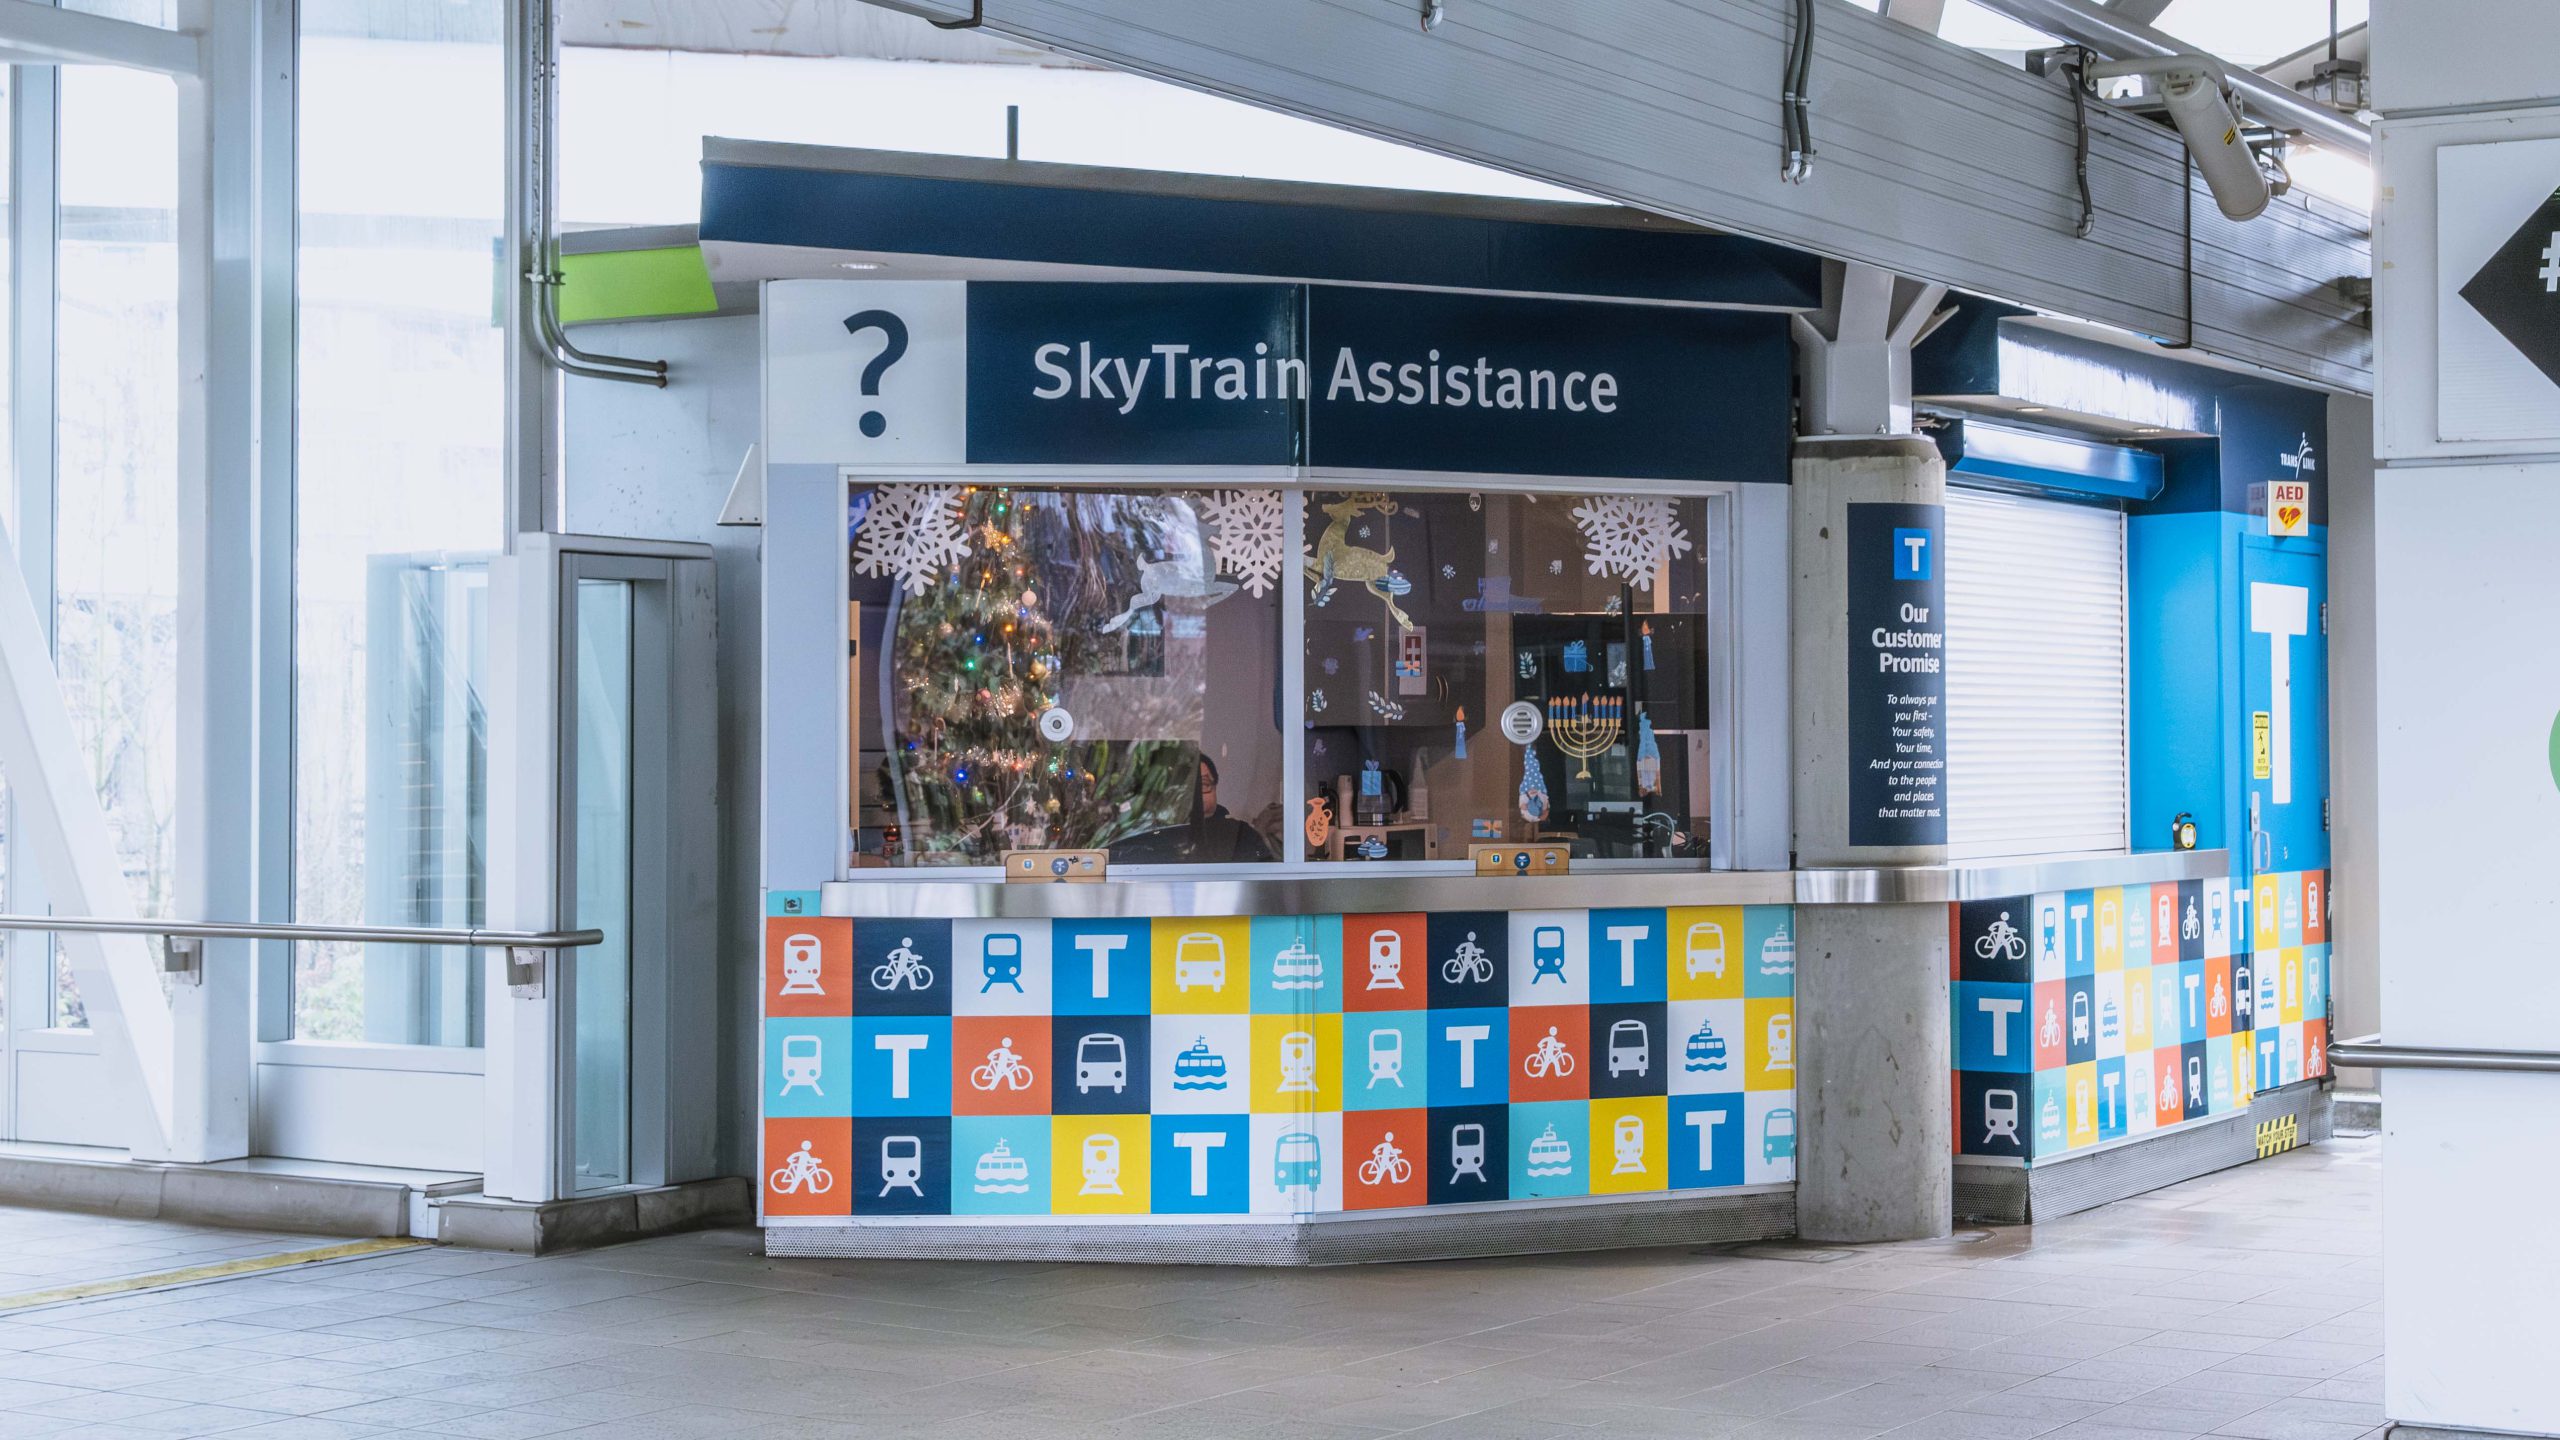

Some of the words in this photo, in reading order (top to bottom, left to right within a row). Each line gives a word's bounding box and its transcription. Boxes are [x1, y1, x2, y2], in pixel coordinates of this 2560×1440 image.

[1032, 340, 1309, 415] SkyTrain
[1327, 346, 1619, 414] Assistance
[2275, 485, 2304, 500] AED
[1904, 537, 1926, 572] T
[1900, 602, 1929, 623] Our
[1871, 627, 1943, 649] Customer
[1879, 652, 1940, 674] Promise
[1887, 694, 1898, 705] To
[1899, 693, 1927, 706] always
[1927, 695, 1938, 707] put
[1894, 711, 1911, 723] you
[1912, 709, 1928, 722] first
[1892, 726, 1912, 737] Your
[1913, 726, 1935, 739] safety,
[1895, 742, 1915, 753] Your
[1916, 742, 1933, 754] time,
[1869, 758, 1891, 769] And
[1892, 760, 1912, 772] your
[1888, 775, 1898, 786] to
[1900, 774, 1914, 785] the
[1915, 774, 1937, 787] people
[1893, 790, 1912, 801] and
[1912, 790, 1935, 804] places
[1878, 806, 1898, 818] that
[1899, 807, 1926, 818] matter
[2285, 1126, 2295, 1138] STEP
